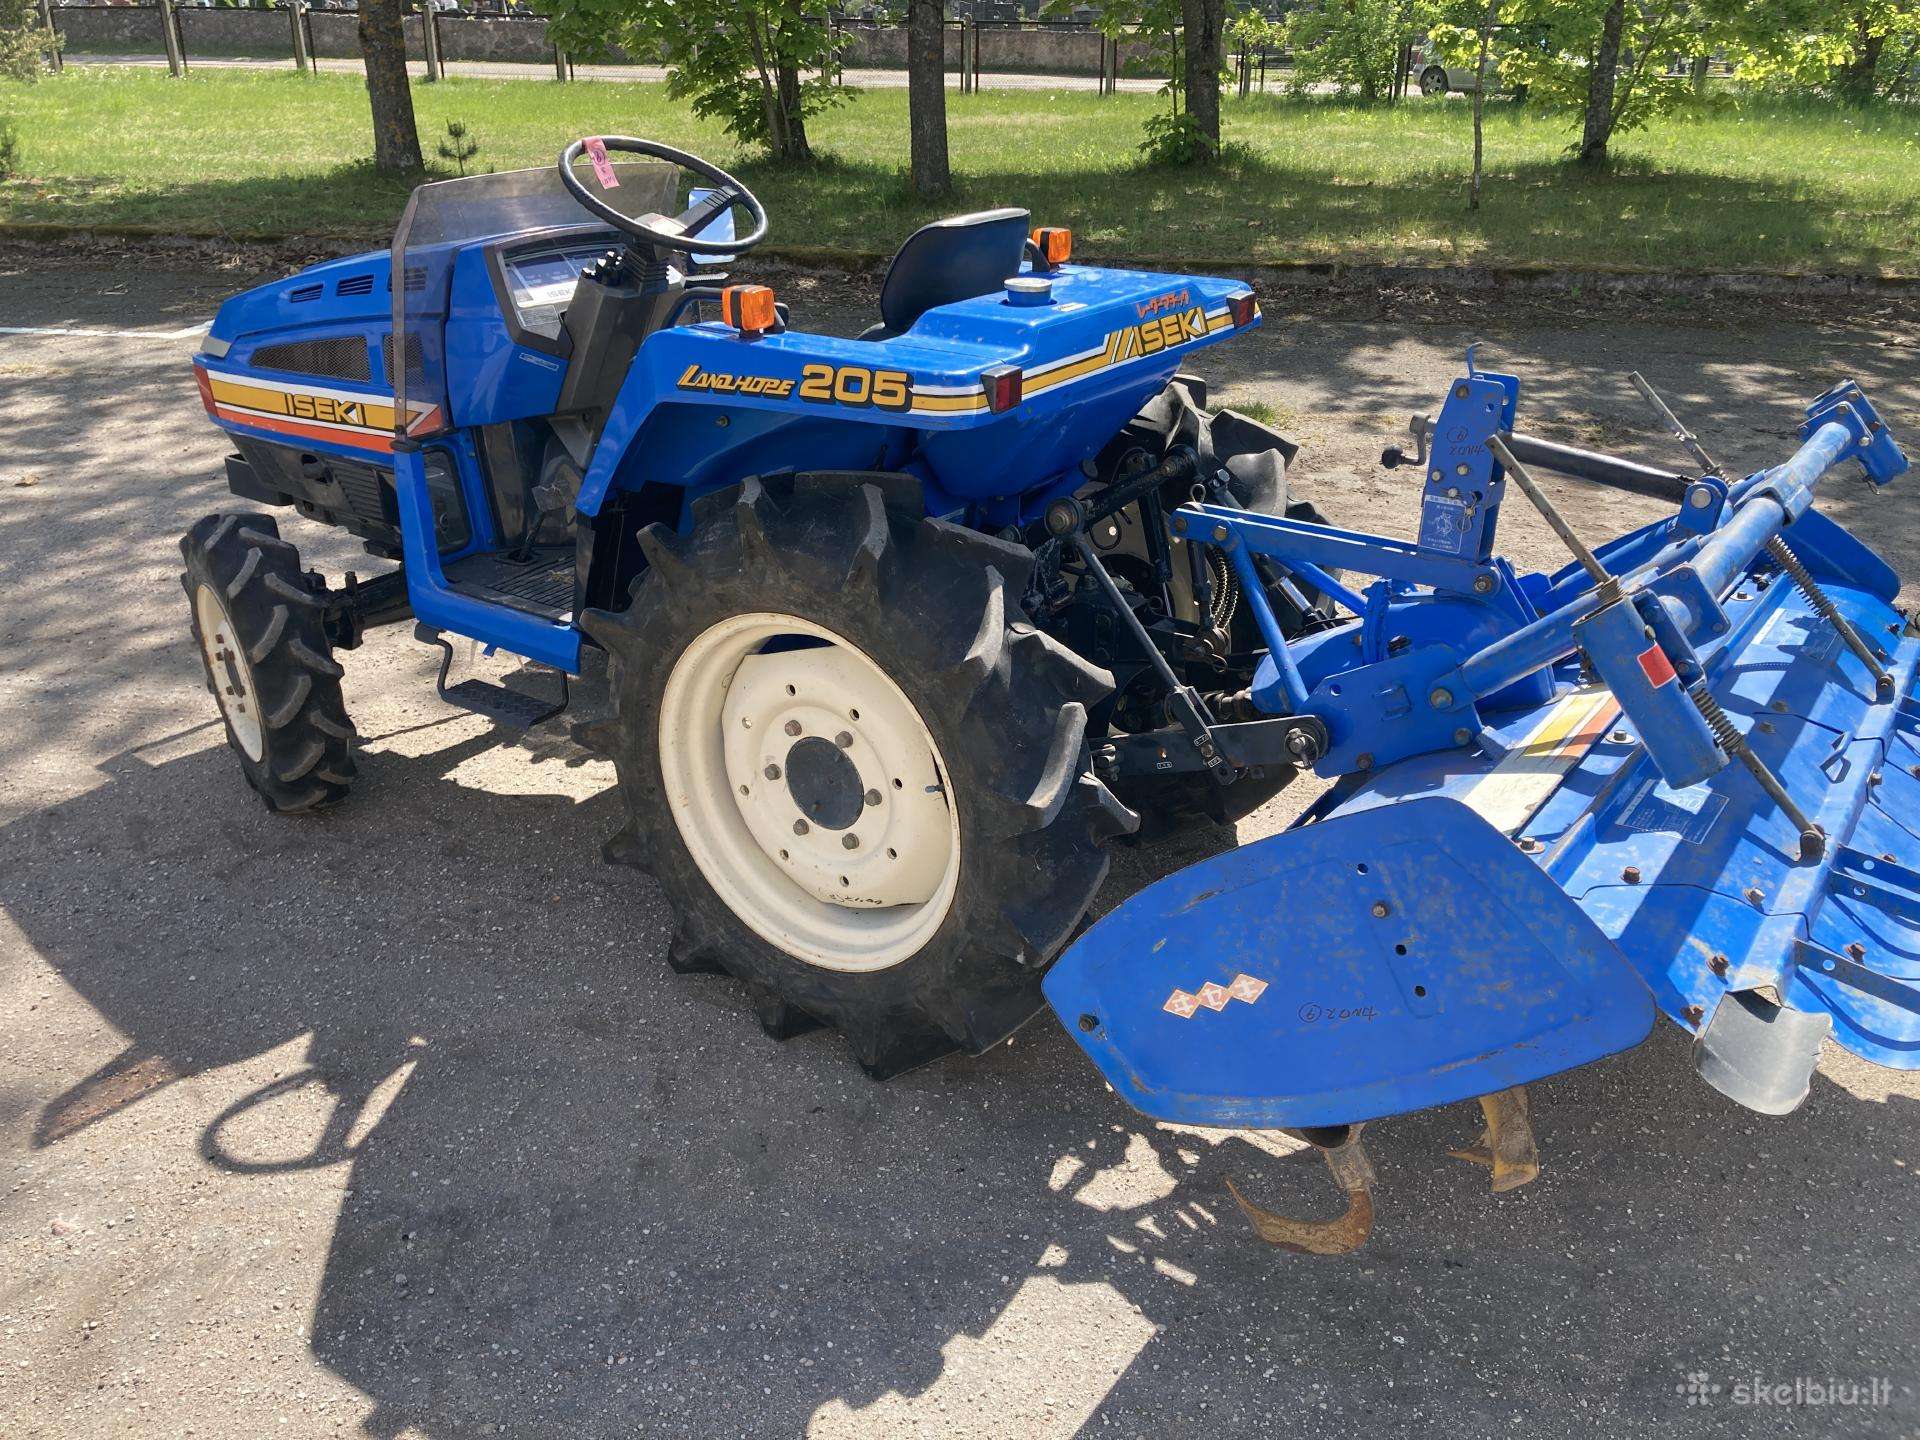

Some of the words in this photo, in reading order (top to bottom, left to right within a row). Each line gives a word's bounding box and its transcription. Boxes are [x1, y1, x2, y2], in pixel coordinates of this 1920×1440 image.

[1131, 306, 1209, 357] ISEKI
[284, 392, 367, 425] ISEKI
[799, 363, 912, 411] 205
